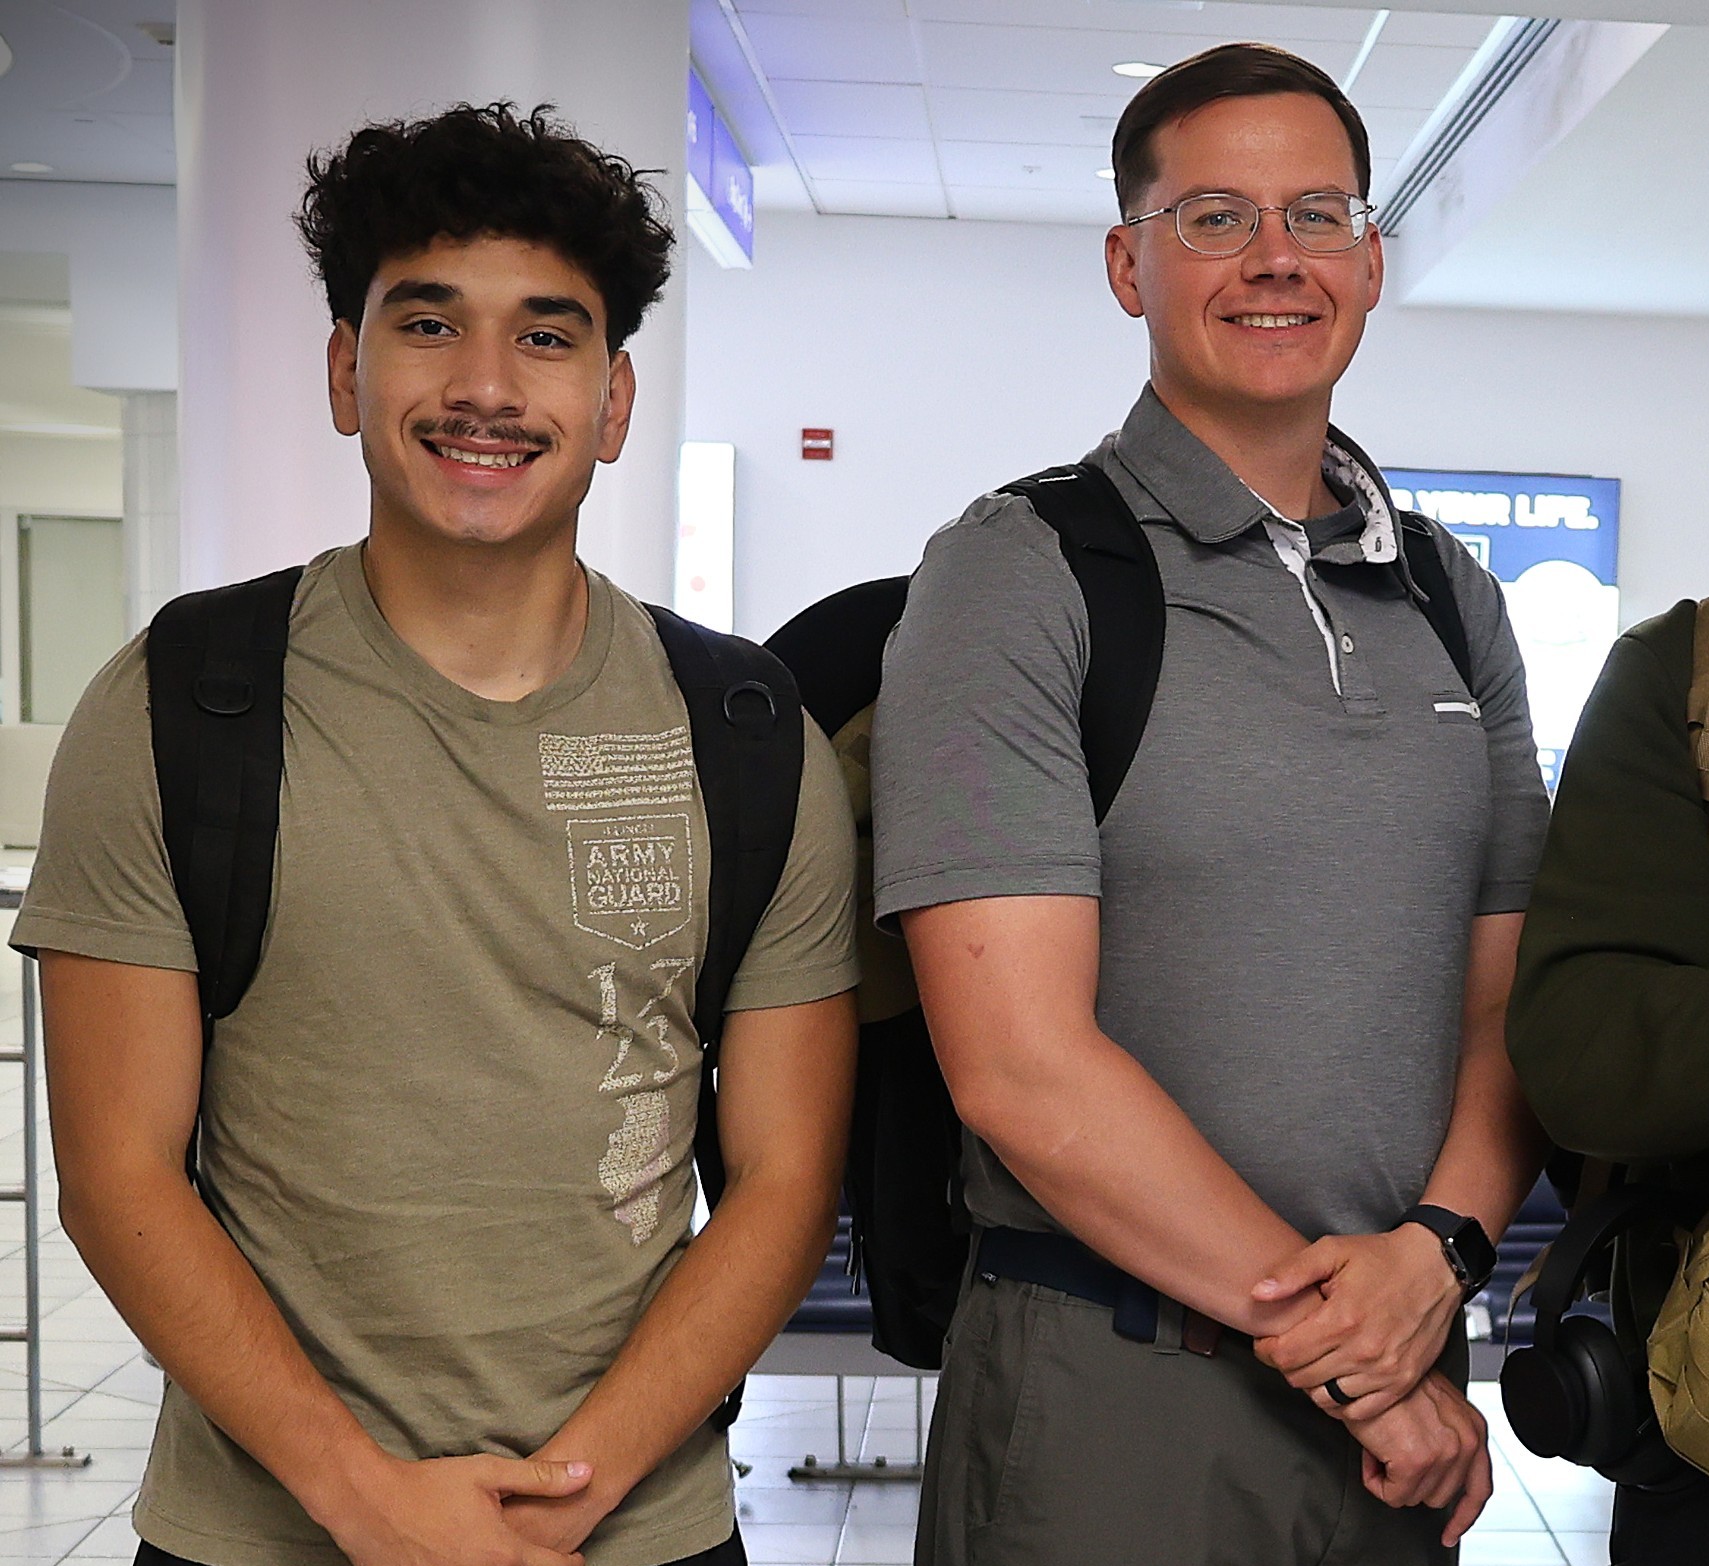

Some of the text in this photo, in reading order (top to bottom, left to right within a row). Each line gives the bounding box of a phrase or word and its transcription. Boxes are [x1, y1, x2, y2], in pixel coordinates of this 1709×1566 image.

[586, 841, 676, 869] ARMY
[587, 867, 680, 885] NATIONAL
[587, 882, 682, 909] GUARD
